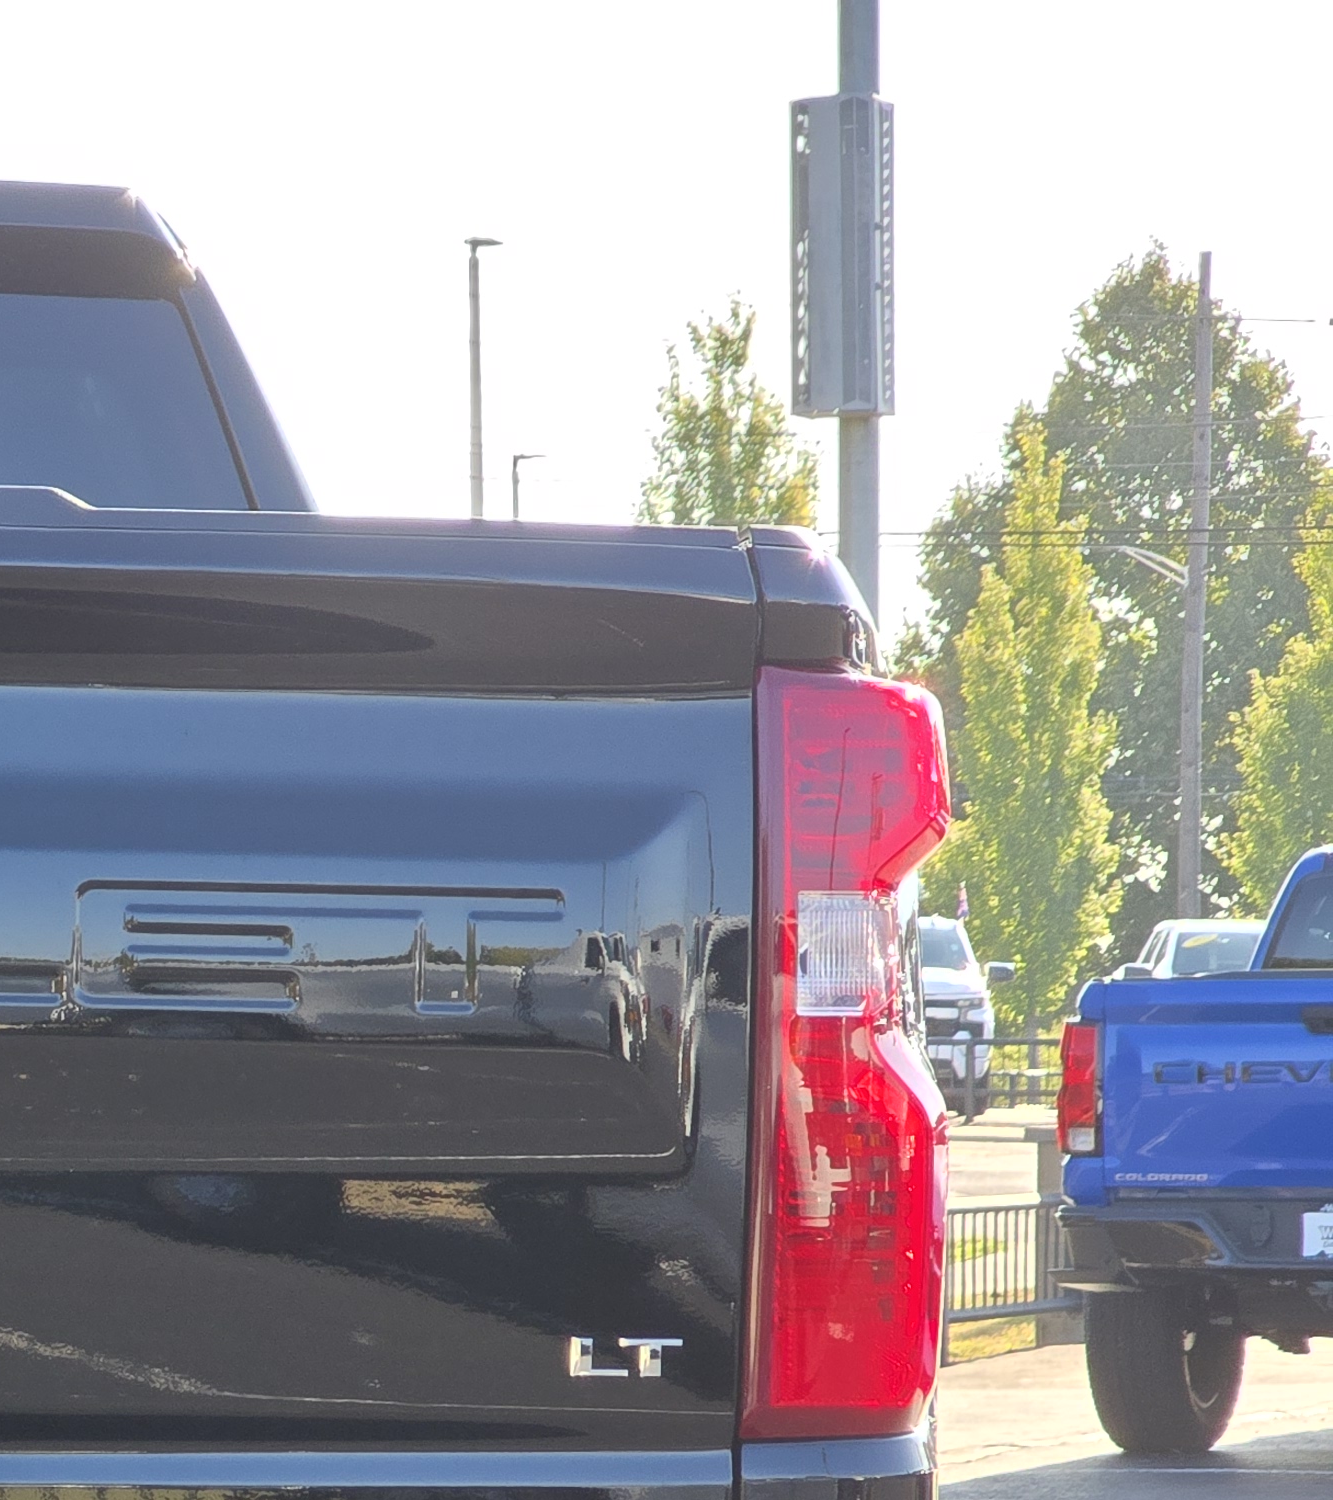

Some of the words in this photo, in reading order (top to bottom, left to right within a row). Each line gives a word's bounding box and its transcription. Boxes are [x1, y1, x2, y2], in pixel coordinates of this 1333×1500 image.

[1153, 1060, 1333, 1084] CHEV
[1114, 1172, 1209, 1182] COLORADO
[569, 1336, 684, 1378] LT
